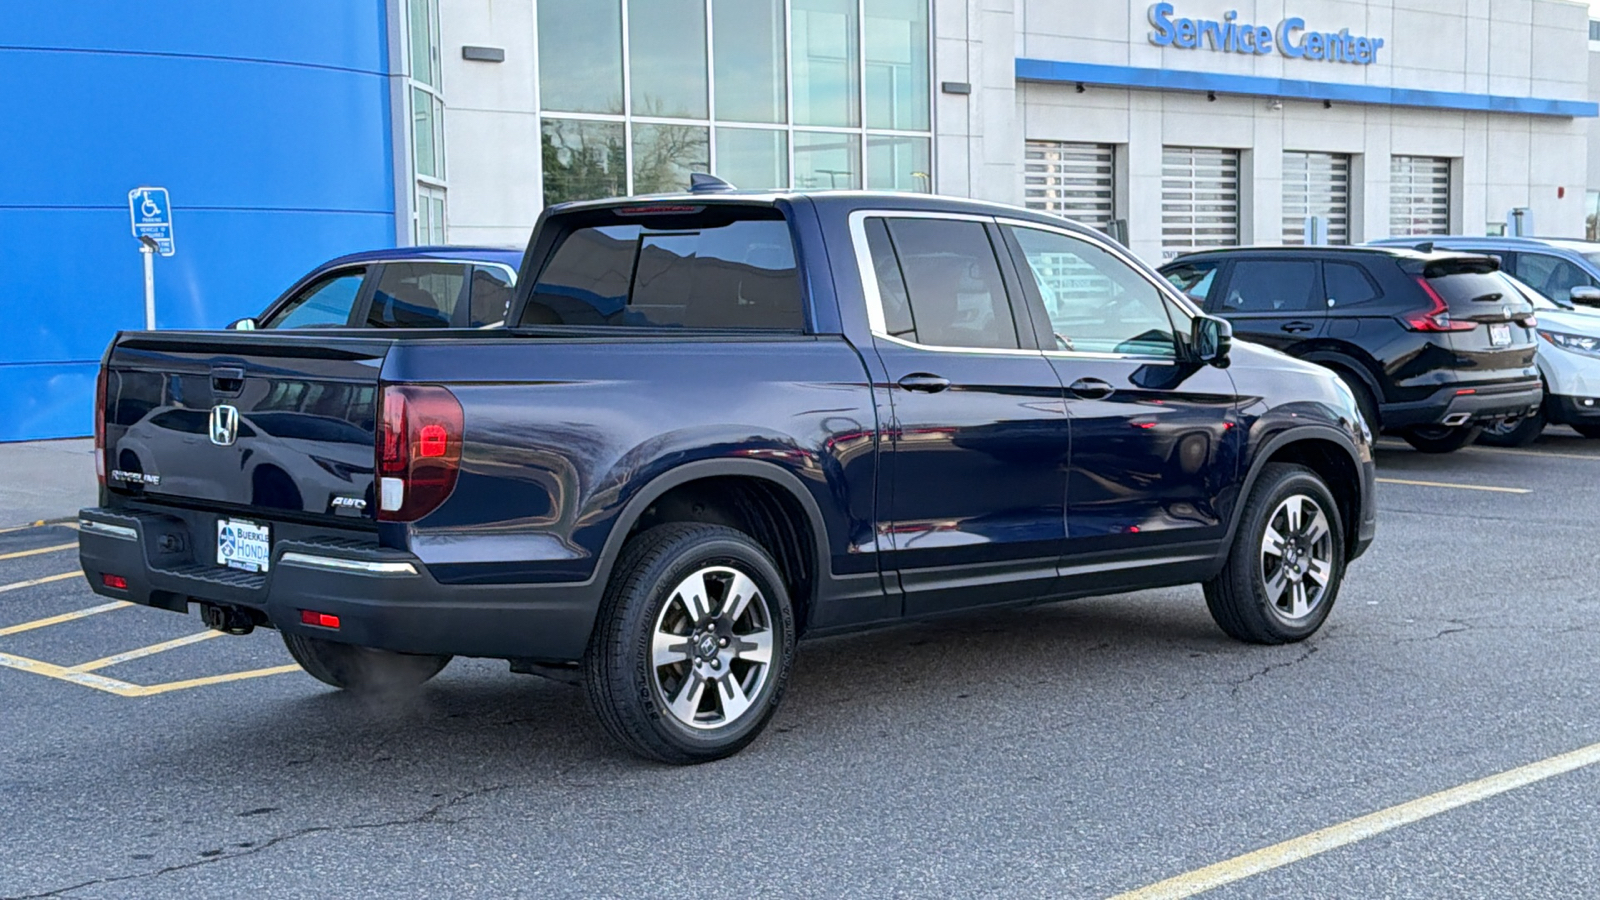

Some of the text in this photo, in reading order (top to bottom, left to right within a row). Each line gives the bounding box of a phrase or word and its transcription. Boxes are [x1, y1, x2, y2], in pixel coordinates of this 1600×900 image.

[1147, 2, 1384, 65] Service Center
[331, 496, 368, 510] AWD
[237, 527, 269, 543] BUERKLE
[237, 540, 269, 561] HONDA
